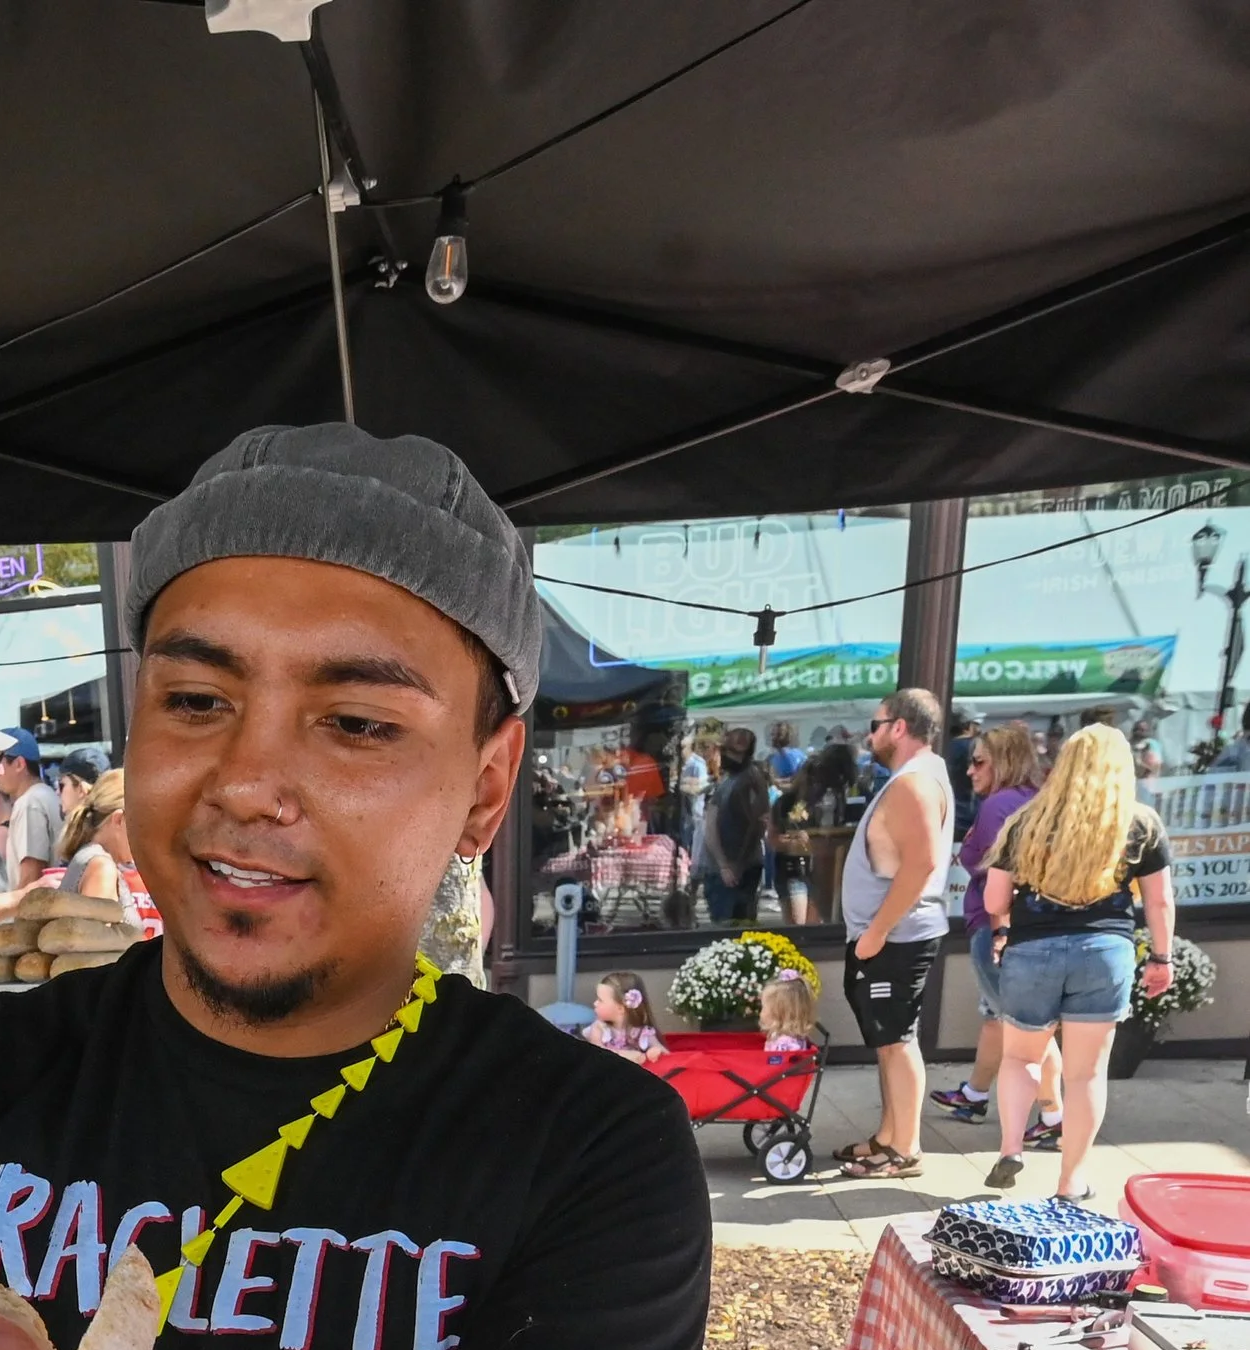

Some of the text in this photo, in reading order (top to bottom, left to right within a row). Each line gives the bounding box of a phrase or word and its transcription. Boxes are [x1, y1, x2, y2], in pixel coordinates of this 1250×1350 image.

[638, 520, 794, 588] BUD
[607, 572, 821, 646] LIGHT
[1202, 860, 1241, 876] YOU
[1218, 881, 1250, 897] 202
